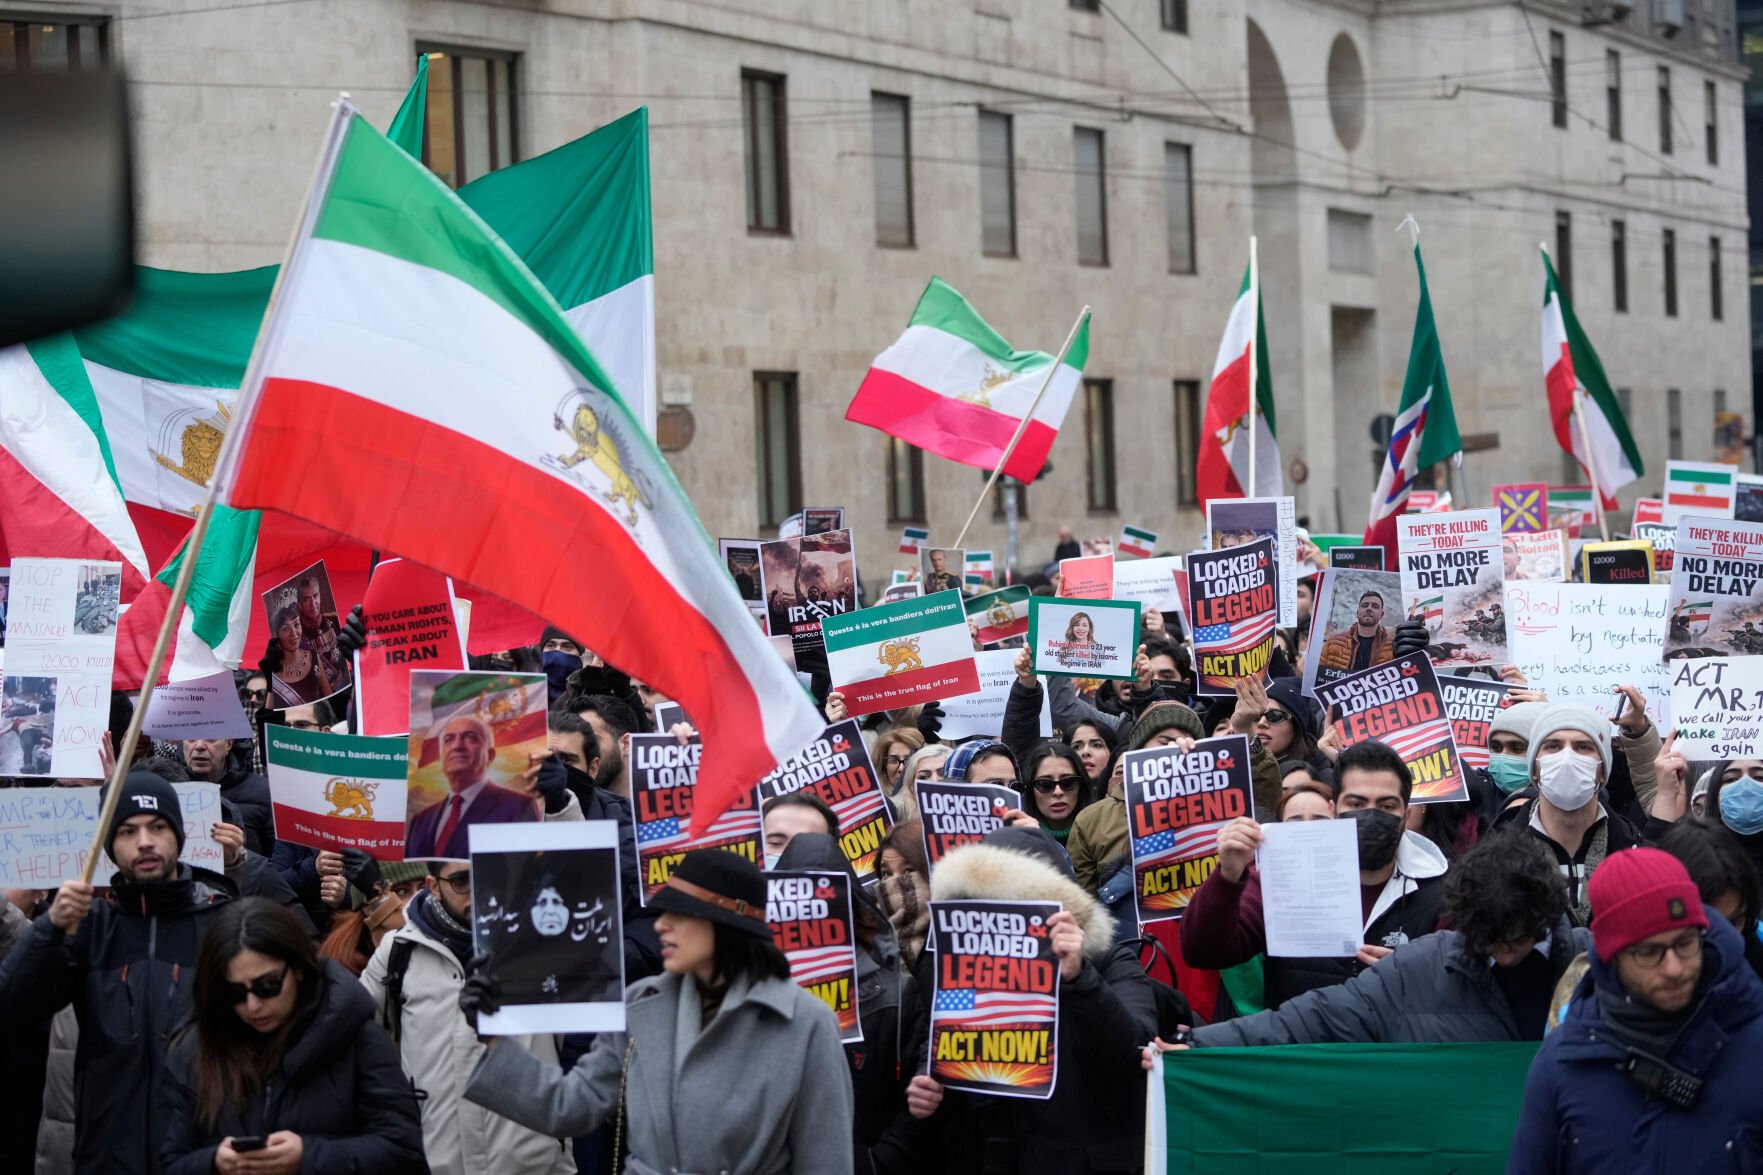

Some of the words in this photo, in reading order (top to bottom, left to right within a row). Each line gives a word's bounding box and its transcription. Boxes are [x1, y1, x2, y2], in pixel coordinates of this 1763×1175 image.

[1408, 523, 1447, 537] THEY'RE
[1449, 520, 1488, 534] KILLING
[1640, 527, 1677, 540] LOCK
[1689, 527, 1729, 542] THEY'RE
[1432, 535, 1464, 549] TODAY
[1712, 543, 1747, 557] TODAY
[1194, 553, 1257, 582] LOCKED
[1258, 551, 1268, 568] &
[1408, 554, 1432, 571] NO
[1436, 550, 1490, 569] MORE
[1682, 557, 1707, 573] NO
[16, 566, 63, 586] STOP
[1204, 569, 1264, 598] LOADED
[1417, 567, 1480, 590] DELAY
[1610, 568, 1645, 580] Killed
[1689, 574, 1757, 596] DELAY
[24, 595, 54, 613] THE
[371, 612, 390, 622] YOU
[392, 608, 415, 620] CARE
[417, 603, 447, 614] ABOUT
[1197, 584, 1273, 626] LEGEND
[1507, 588, 1561, 616] Blood
[1570, 594, 1607, 616] isn't
[367, 623, 405, 636] HUMAN
[408, 616, 452, 630] RIGHTS,
[795, 631, 819, 639] POPOLO
[828, 626, 854, 638] Questa
[861, 621, 870, 630] la
[870, 618, 888, 627] vera
[889, 609, 924, 623] bandiera
[370, 636, 408, 648] SPEAK
[411, 630, 448, 643] ABOUT
[1571, 625, 1593, 654] by
[1603, 626, 1664, 649] negotiatio
[385, 645, 438, 665] IRAN
[1054, 650, 1075, 658] student
[1076, 651, 1090, 659] killed
[1091, 652, 1098, 660] by
[1098, 653, 1118, 661] Islamic
[1060, 659, 1081, 668] Regime
[1088, 661, 1102, 669] IRAN
[1203, 655, 1235, 676] ACT
[1239, 637, 1273, 677] NOW!
[1553, 654, 1631, 675] handshakes
[1322, 666, 1400, 705] LOCKED
[1400, 661, 1420, 677] &
[1674, 662, 1728, 687] ACT
[59, 685, 101, 709] ACT
[856, 694, 874, 703] This
[875, 691, 883, 699] is
[884, 688, 897, 698] the
[898, 686, 915, 695] true
[916, 682, 932, 692] flag
[933, 679, 941, 688] of
[943, 677, 959, 686] Iran
[1340, 677, 1419, 717] LOADED
[1443, 685, 1500, 707] OCKED
[1557, 682, 1569, 696] is
[1576, 686, 1585, 695] a
[1335, 692, 1440, 748] LEGEND
[1448, 704, 1504, 722] OADE
[1679, 716, 1698, 724] we
[1727, 715, 1753, 725] your
[1722, 728, 1760, 740] IRAN
[272, 739, 303, 753] Questa
[313, 746, 322, 755] la
[324, 749, 345, 758] vera
[348, 750, 391, 760] bandiera
[637, 743, 703, 770] LOCKE
[762, 739, 833, 784] CKED
[832, 734, 852, 752] &
[1711, 741, 1754, 759] again
[771, 752, 850, 797] LOADED
[1131, 750, 1215, 784] LOCKED
[1216, 749, 1235, 769] &
[1406, 748, 1453, 785] OW!
[1142, 770, 1229, 802] LOADED
[921, 791, 990, 816] LOCKED
[992, 797, 1009, 817] &
[1135, 788, 1246, 838] LEGEND
[295, 823, 312, 834] This
[313, 829, 321, 837] is
[322, 831, 336, 841] the
[337, 836, 356, 845] true
[358, 838, 377, 848] flag
[379, 838, 389, 847] of
[931, 814, 1004, 835] LOADED
[16, 852, 70, 882] HELP
[74, 849, 114, 875] IRN
[1142, 865, 1180, 897] ACT
[1184, 856, 1221, 889] NO
[767, 878, 814, 901] KED
[815, 877, 837, 899] &
[765, 899, 829, 924] ADED
[938, 909, 1026, 936] LOCKED
[1028, 915, 1048, 937] &
[767, 918, 847, 951] GEND
[951, 932, 1039, 959] LOADED
[942, 954, 1053, 993] LEGEND
[936, 1031, 978, 1061] ACT
[982, 1031, 1049, 1065] NOW!
